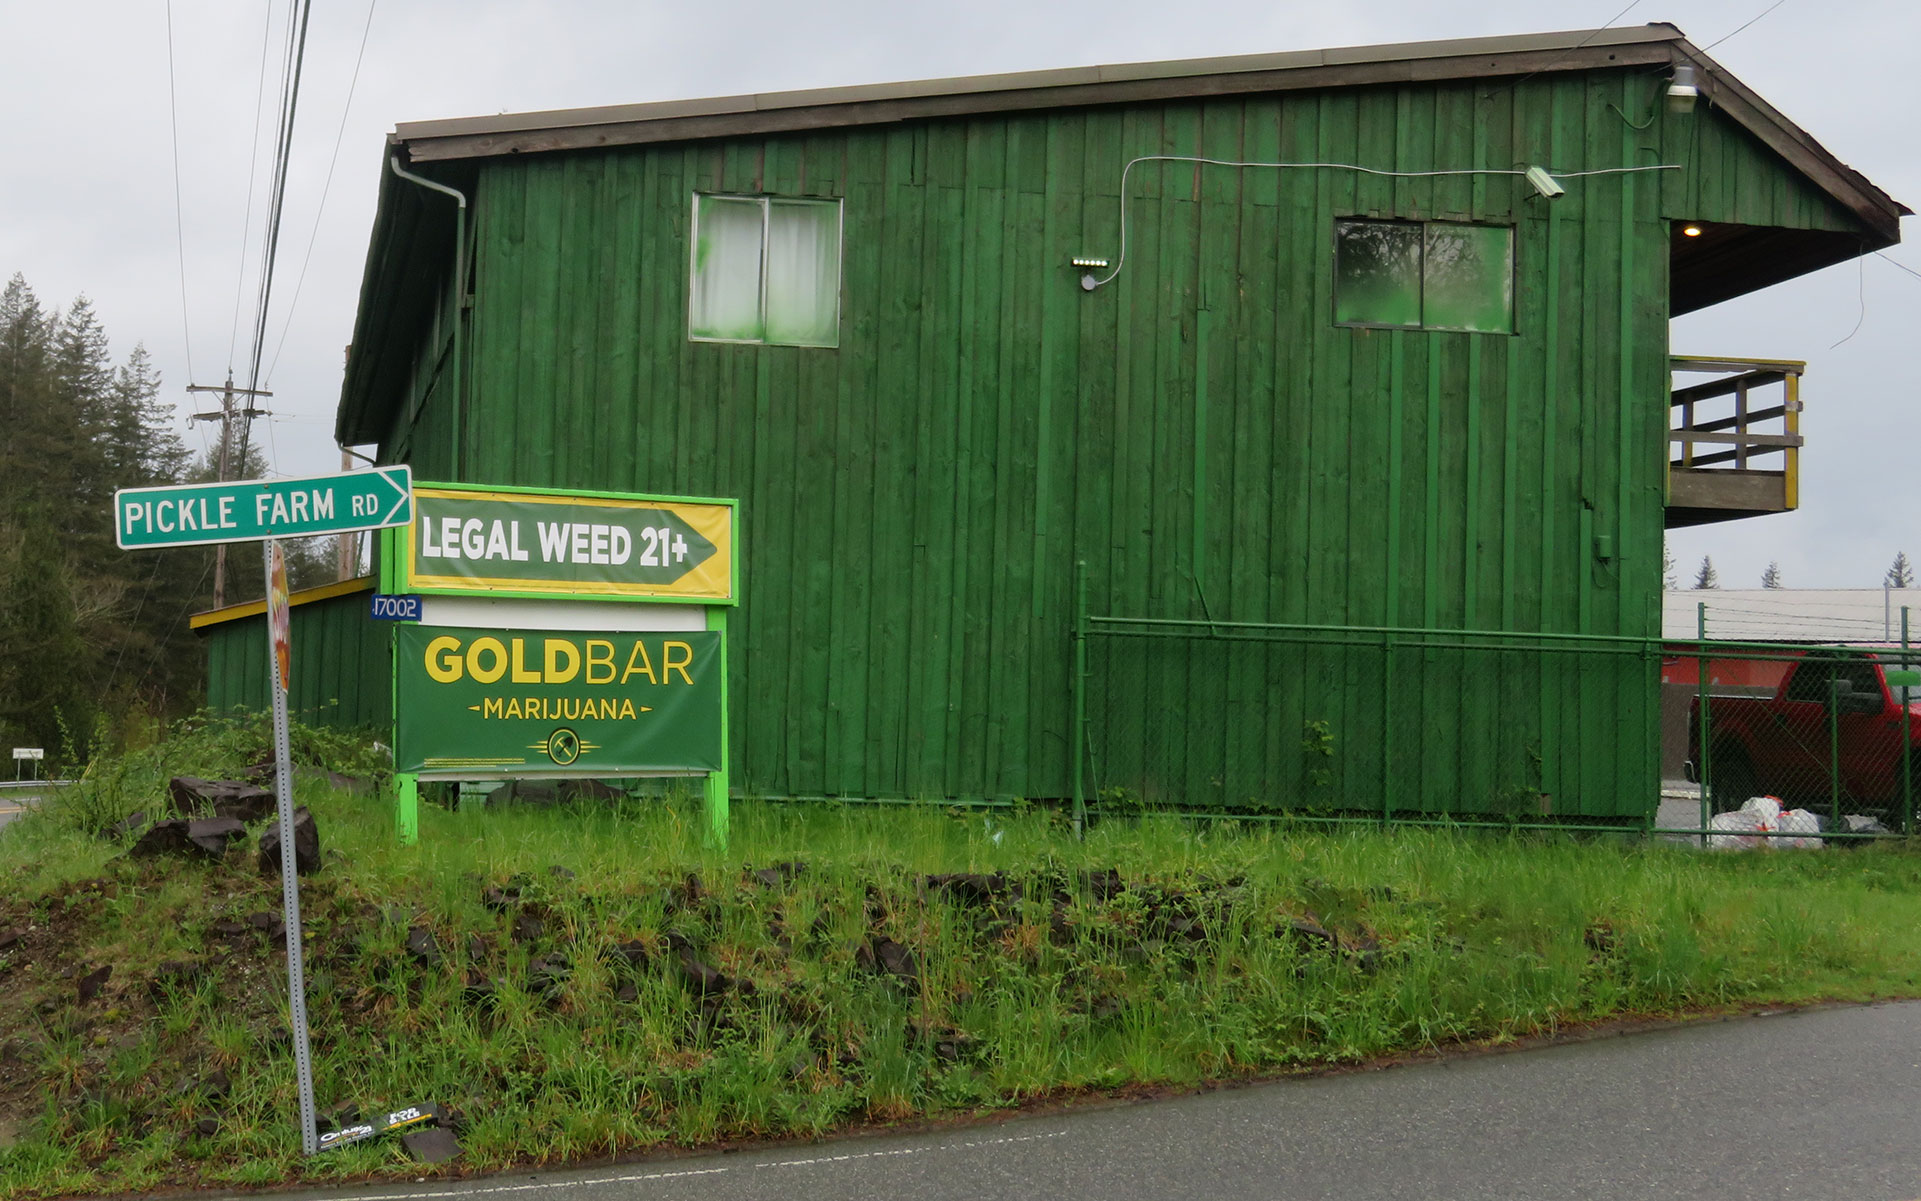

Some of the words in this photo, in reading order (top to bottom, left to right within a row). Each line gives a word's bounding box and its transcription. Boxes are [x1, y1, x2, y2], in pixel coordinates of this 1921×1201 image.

[125, 496, 237, 535] PICKLE
[255, 488, 335, 526] FARM
[352, 493, 379, 517] RD
[422, 516, 529, 562] LEGAL
[537, 521, 632, 565] WEED
[640, 526, 688, 567] 21+
[374, 597, 417, 617] 17002
[483, 697, 637, 720] MARIJUANA
